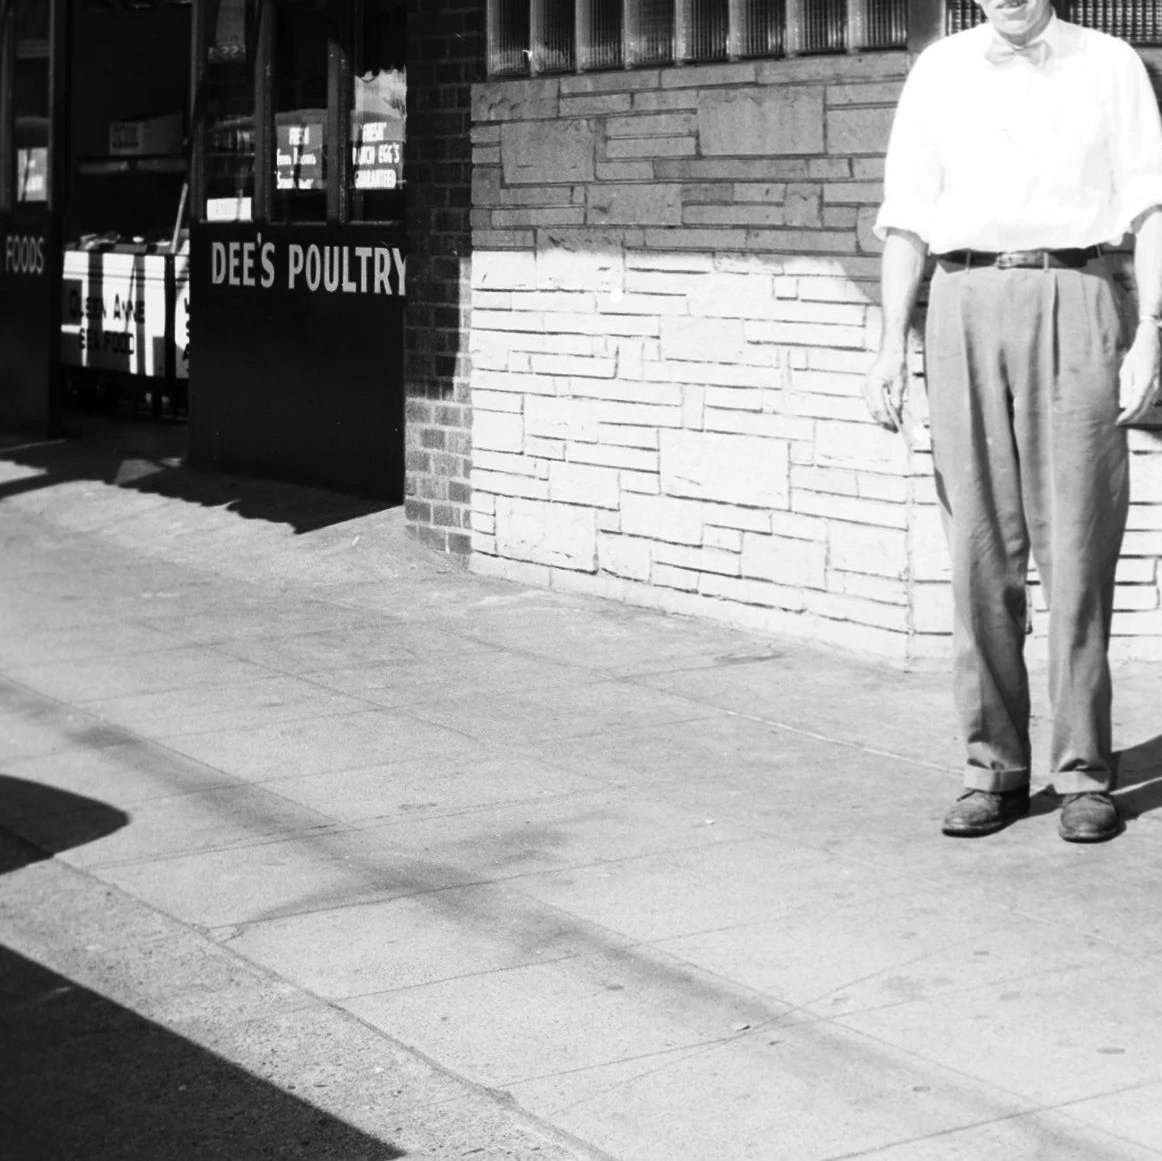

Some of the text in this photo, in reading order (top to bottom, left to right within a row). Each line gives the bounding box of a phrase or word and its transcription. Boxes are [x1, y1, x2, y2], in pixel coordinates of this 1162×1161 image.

[5, 234, 44, 274] FOODS
[212, 232, 406, 296] DEE'S POULTRY
